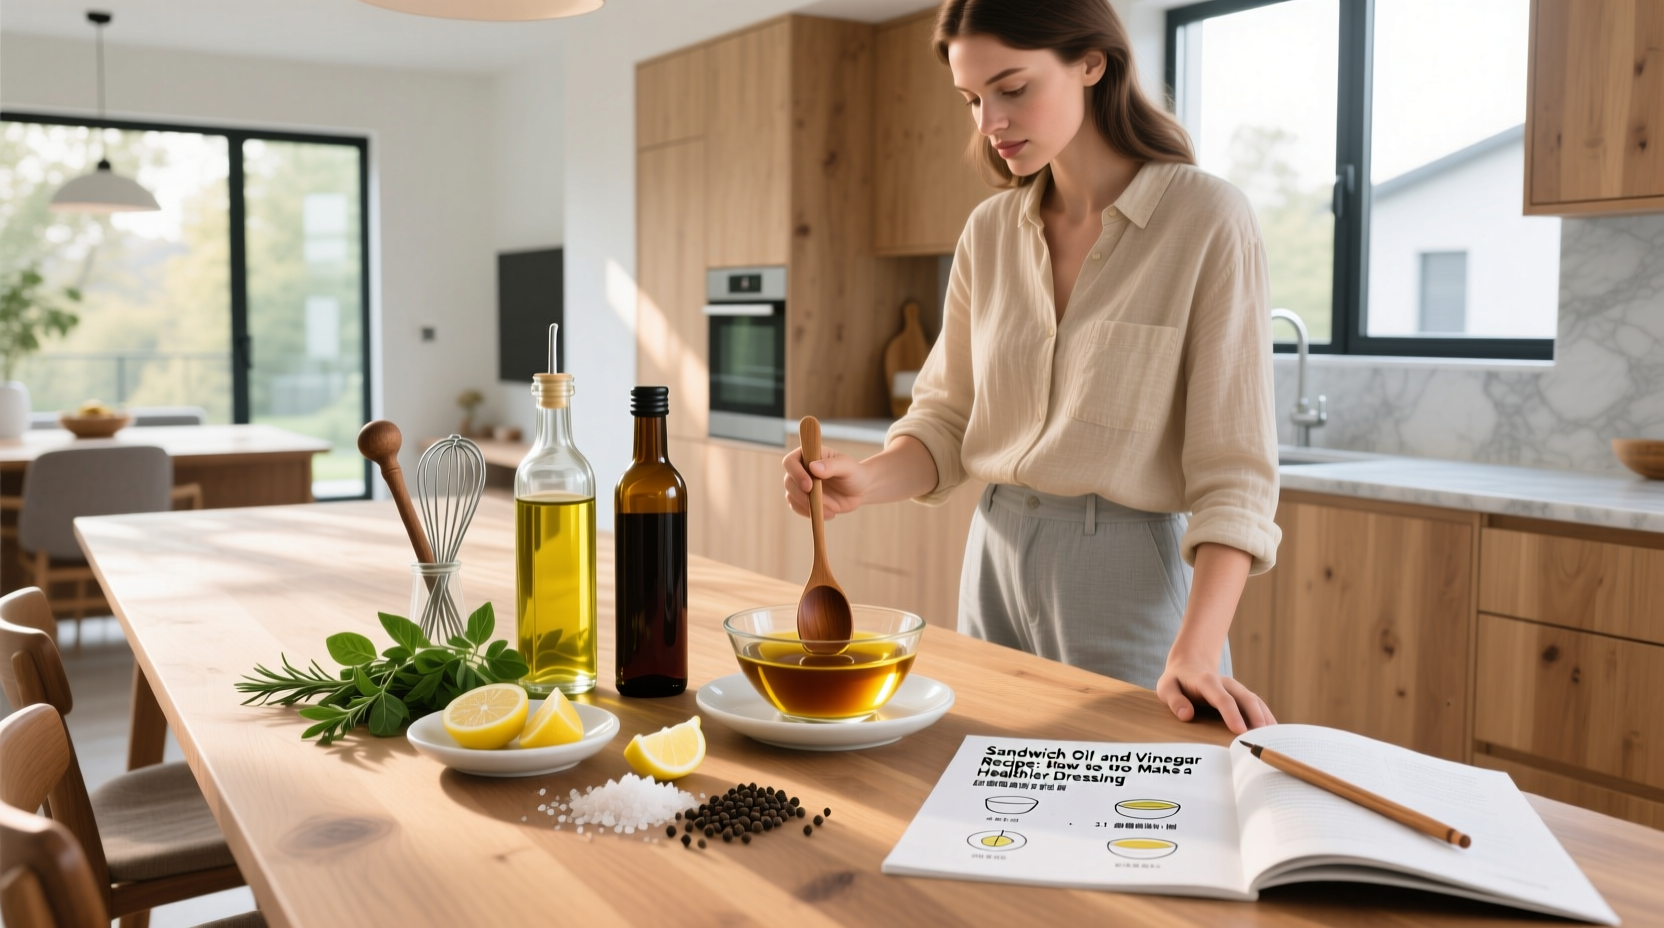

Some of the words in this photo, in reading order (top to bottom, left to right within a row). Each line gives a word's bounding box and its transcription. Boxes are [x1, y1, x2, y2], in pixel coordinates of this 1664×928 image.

[985, 745, 1066, 760] Sandwich
[1101, 751, 1131, 762] and
[1136, 752, 1202, 767] Vinegar
[1053, 771, 1126, 787] Dressing
